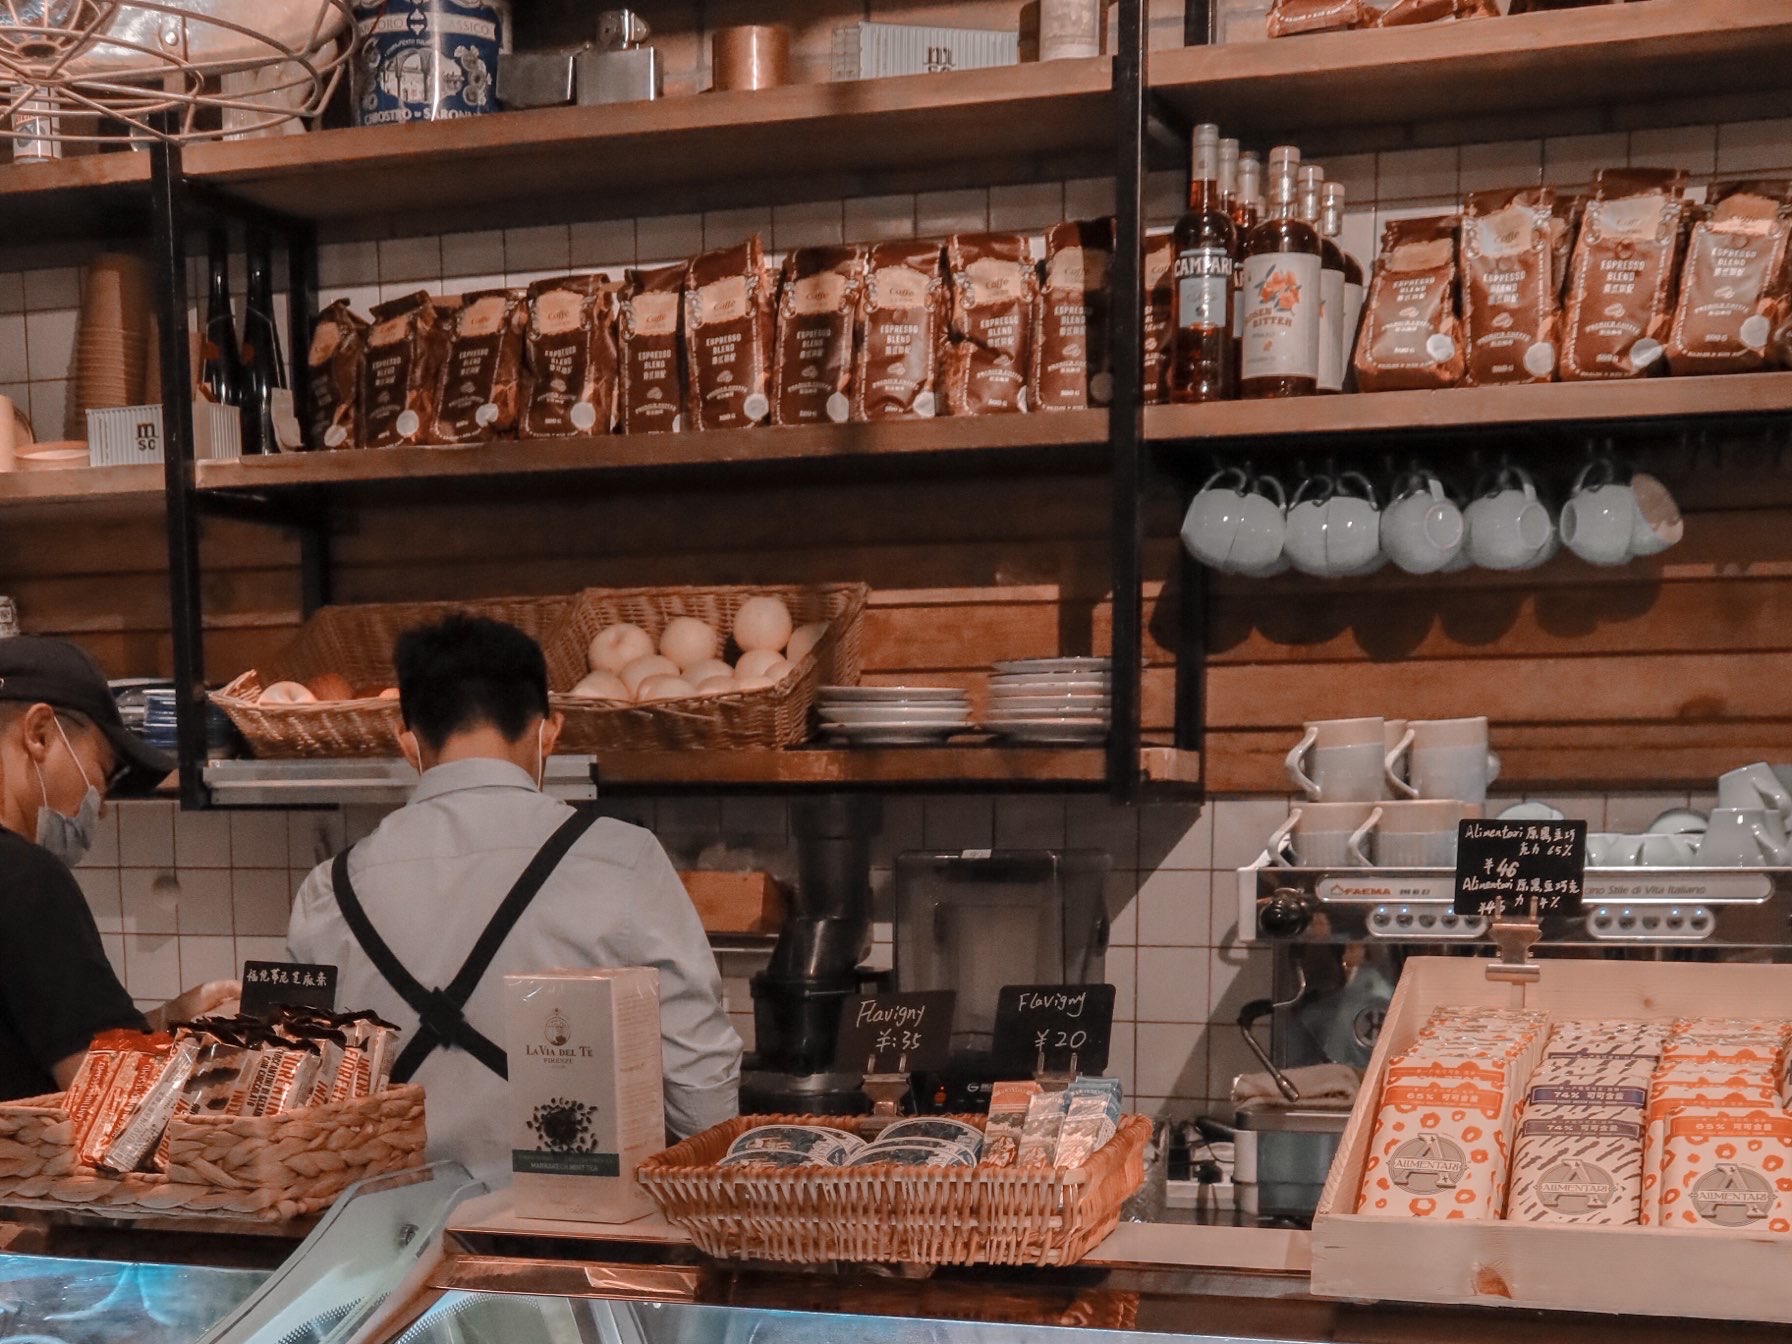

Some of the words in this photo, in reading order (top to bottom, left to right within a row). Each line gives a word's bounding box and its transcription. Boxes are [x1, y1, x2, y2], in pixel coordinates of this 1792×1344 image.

[1174, 258, 1233, 277] CAMPARI
[1600, 259, 1645, 272] ESPRESSO
[1343, 887, 1392, 896] FAEMA
[1018, 992, 1087, 1018] Flavigny
[856, 999, 926, 1027] Flavigny
[1554, 1091, 1580, 1099] 74%
[1696, 1123, 1725, 1131] 65%
[1395, 1159, 1462, 1171] ALIMENTARI
[1542, 1183, 1610, 1193] ALIMENTARI
[1700, 1191, 1768, 1202] ALIMENTARI
